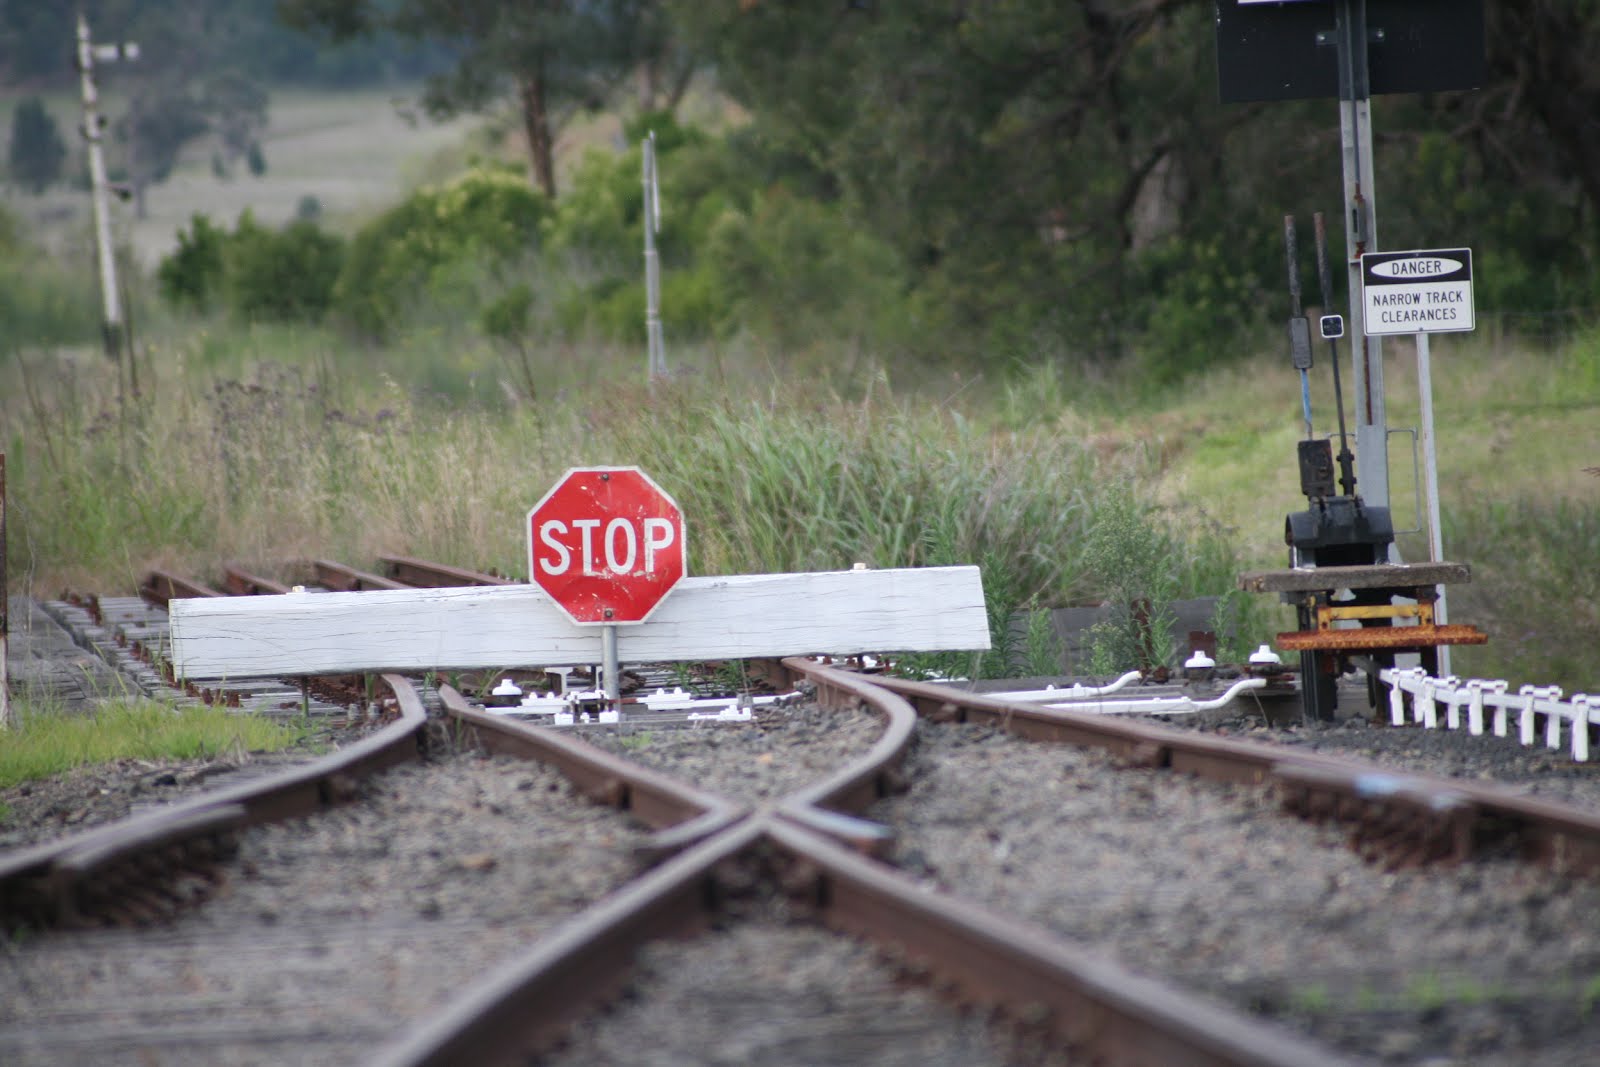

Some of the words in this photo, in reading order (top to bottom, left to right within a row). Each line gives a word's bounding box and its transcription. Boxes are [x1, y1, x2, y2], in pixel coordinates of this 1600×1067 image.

[1392, 261, 1442, 275] DANGER
[1373, 292, 1421, 307] NARROW
[1426, 290, 1463, 304] TRACK
[1381, 307, 1457, 323] CLEARANCES
[539, 517, 675, 576] STOP
